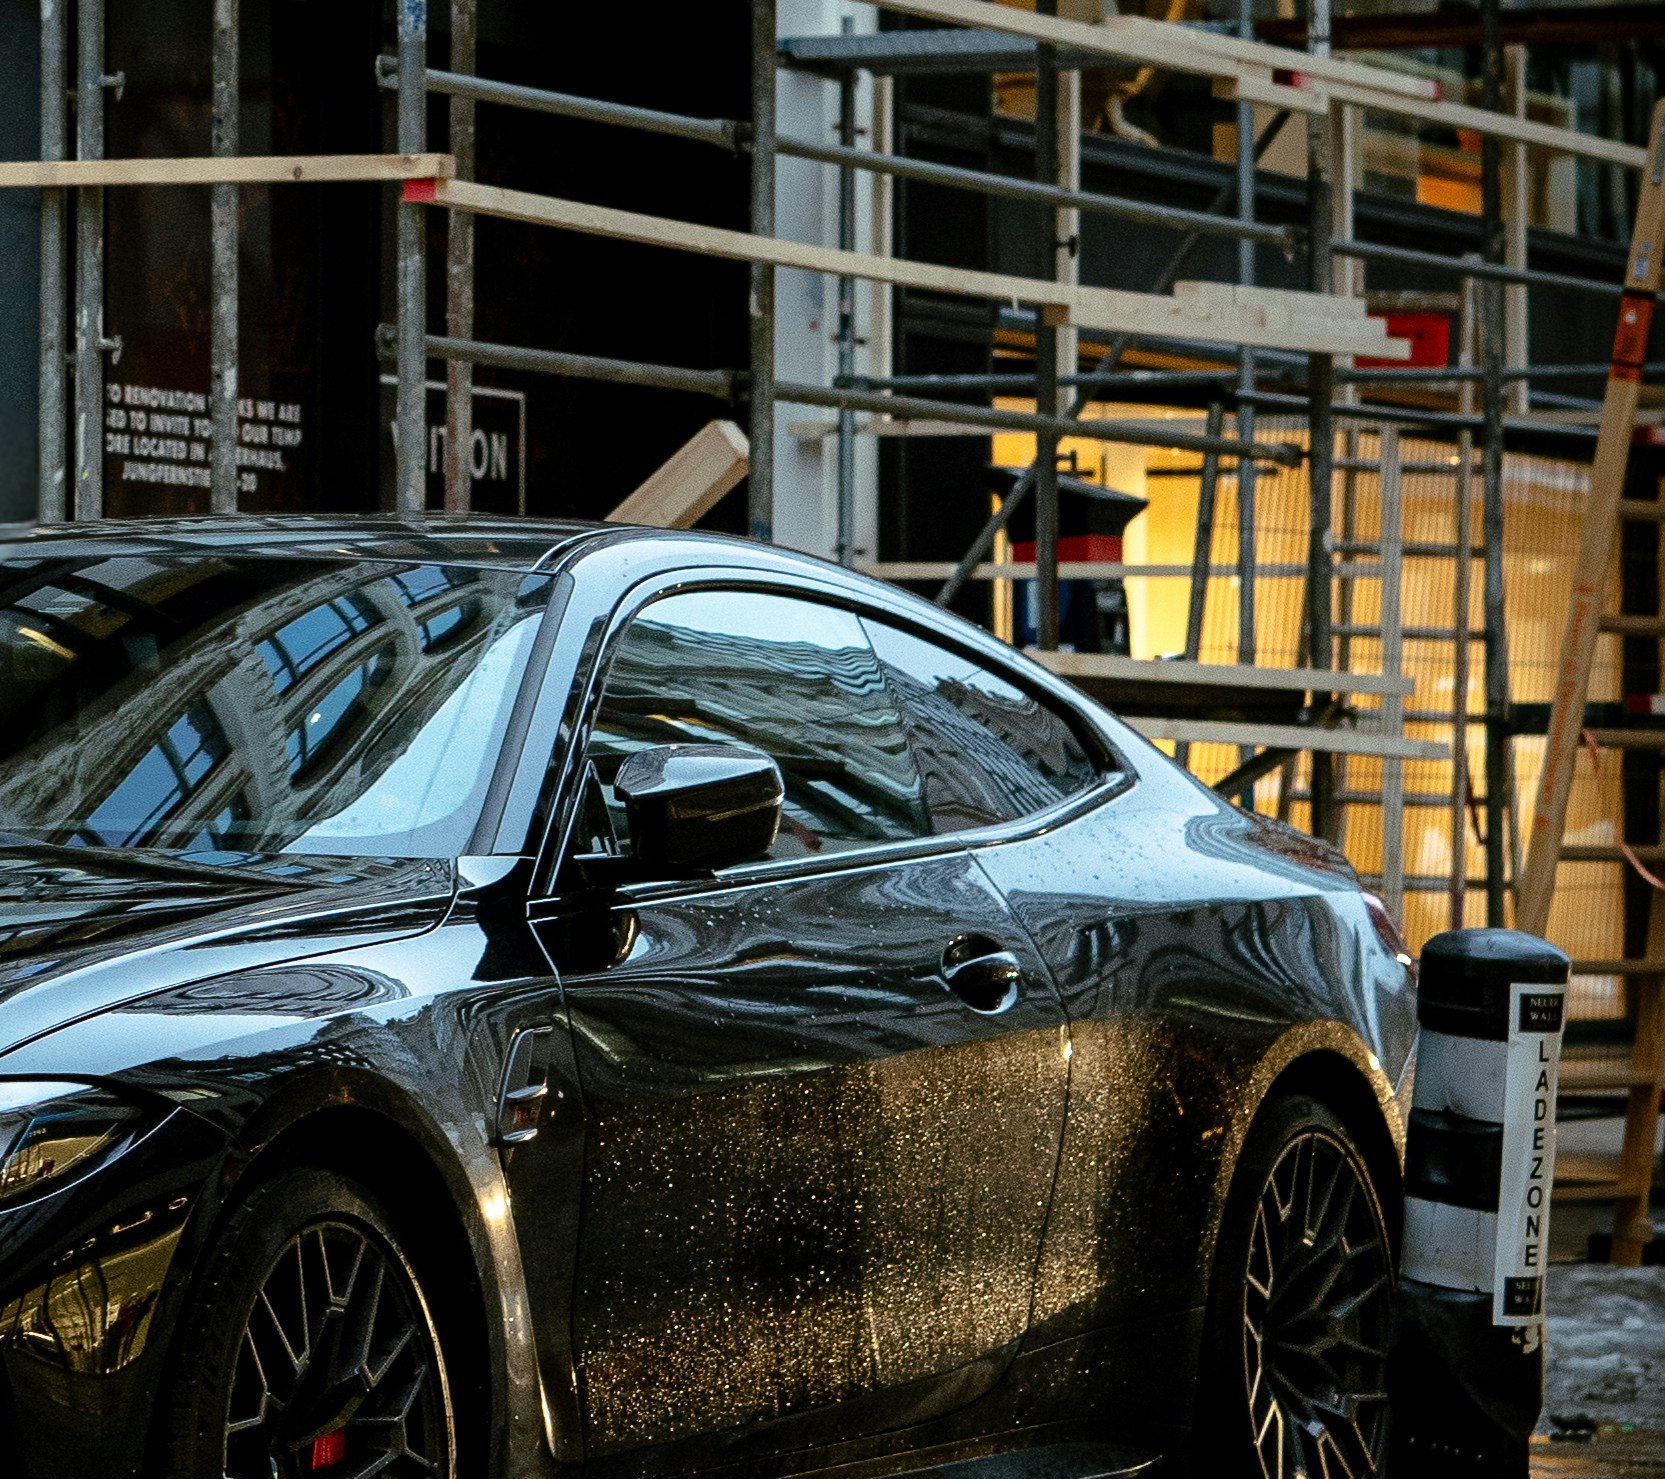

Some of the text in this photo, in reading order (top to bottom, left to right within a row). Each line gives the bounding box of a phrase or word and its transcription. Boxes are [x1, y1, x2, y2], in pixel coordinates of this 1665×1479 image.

[123, 383, 207, 413] RENOVATION
[278, 403, 301, 423] ARE
[129, 409, 147, 432] TO
[149, 412, 191, 437] INVITE
[193, 418, 213, 439] YO
[241, 422, 269, 445] OUR
[132, 435, 188, 460] LOCATED
[189, 441, 206, 462] IN
[1525, 1041, 1549, 1266] LADEZONE
